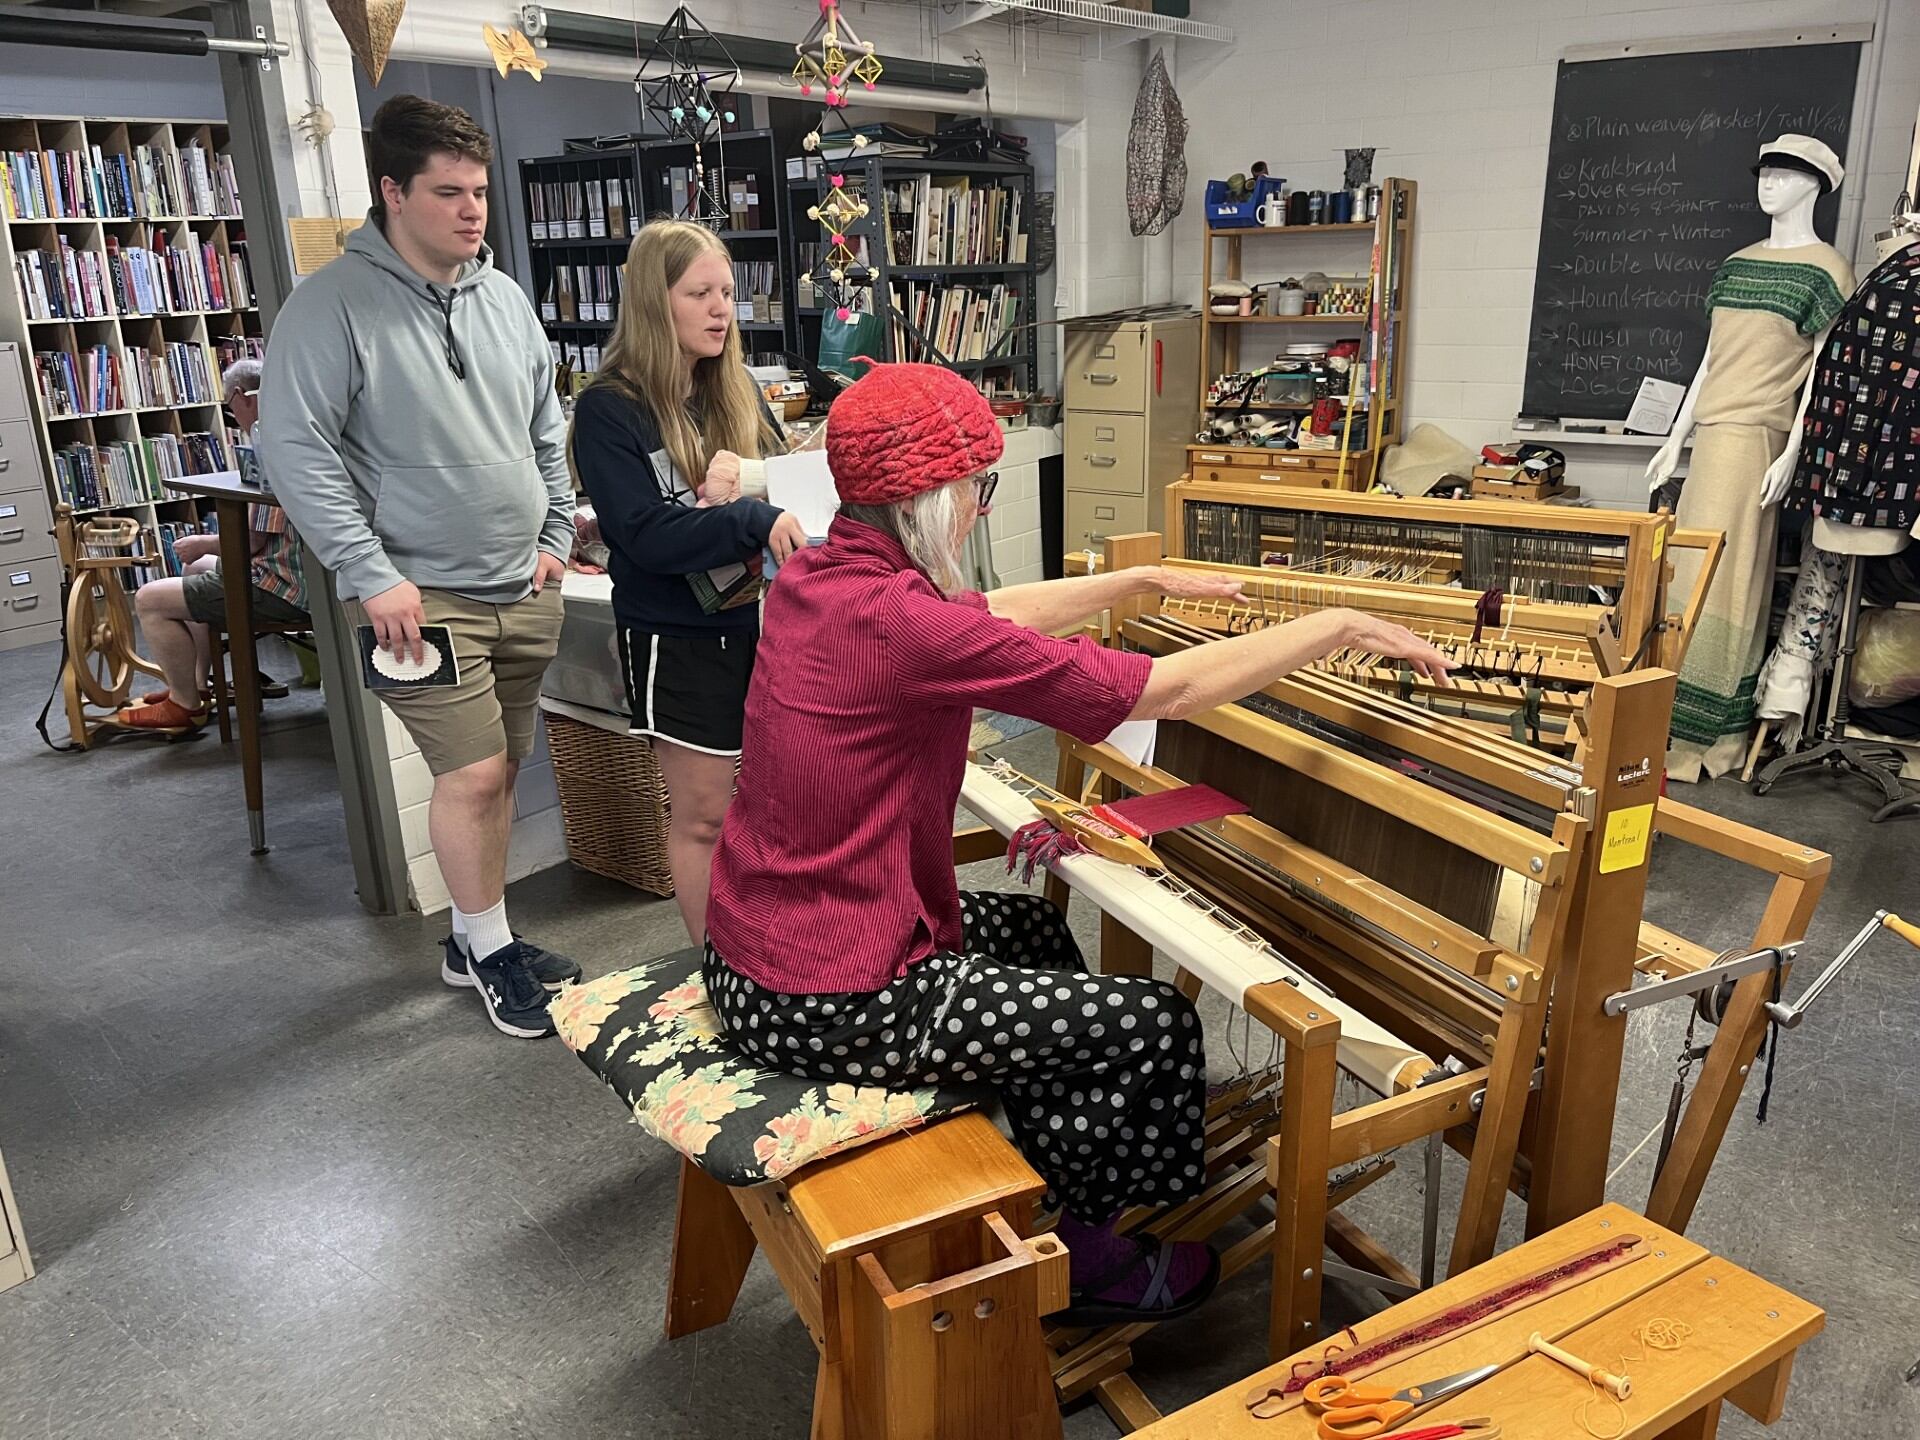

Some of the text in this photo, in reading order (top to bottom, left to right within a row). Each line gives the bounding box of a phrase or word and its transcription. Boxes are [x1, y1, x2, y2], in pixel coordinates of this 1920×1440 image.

[1585, 115, 1630, 139] Plain
[1573, 224, 1653, 247] Summer
[1672, 222, 1732, 241] Winter
[1573, 251, 1719, 276] Double Weave
[1649, 326, 1683, 352] rug
[1617, 768, 1651, 782] Leclerc
